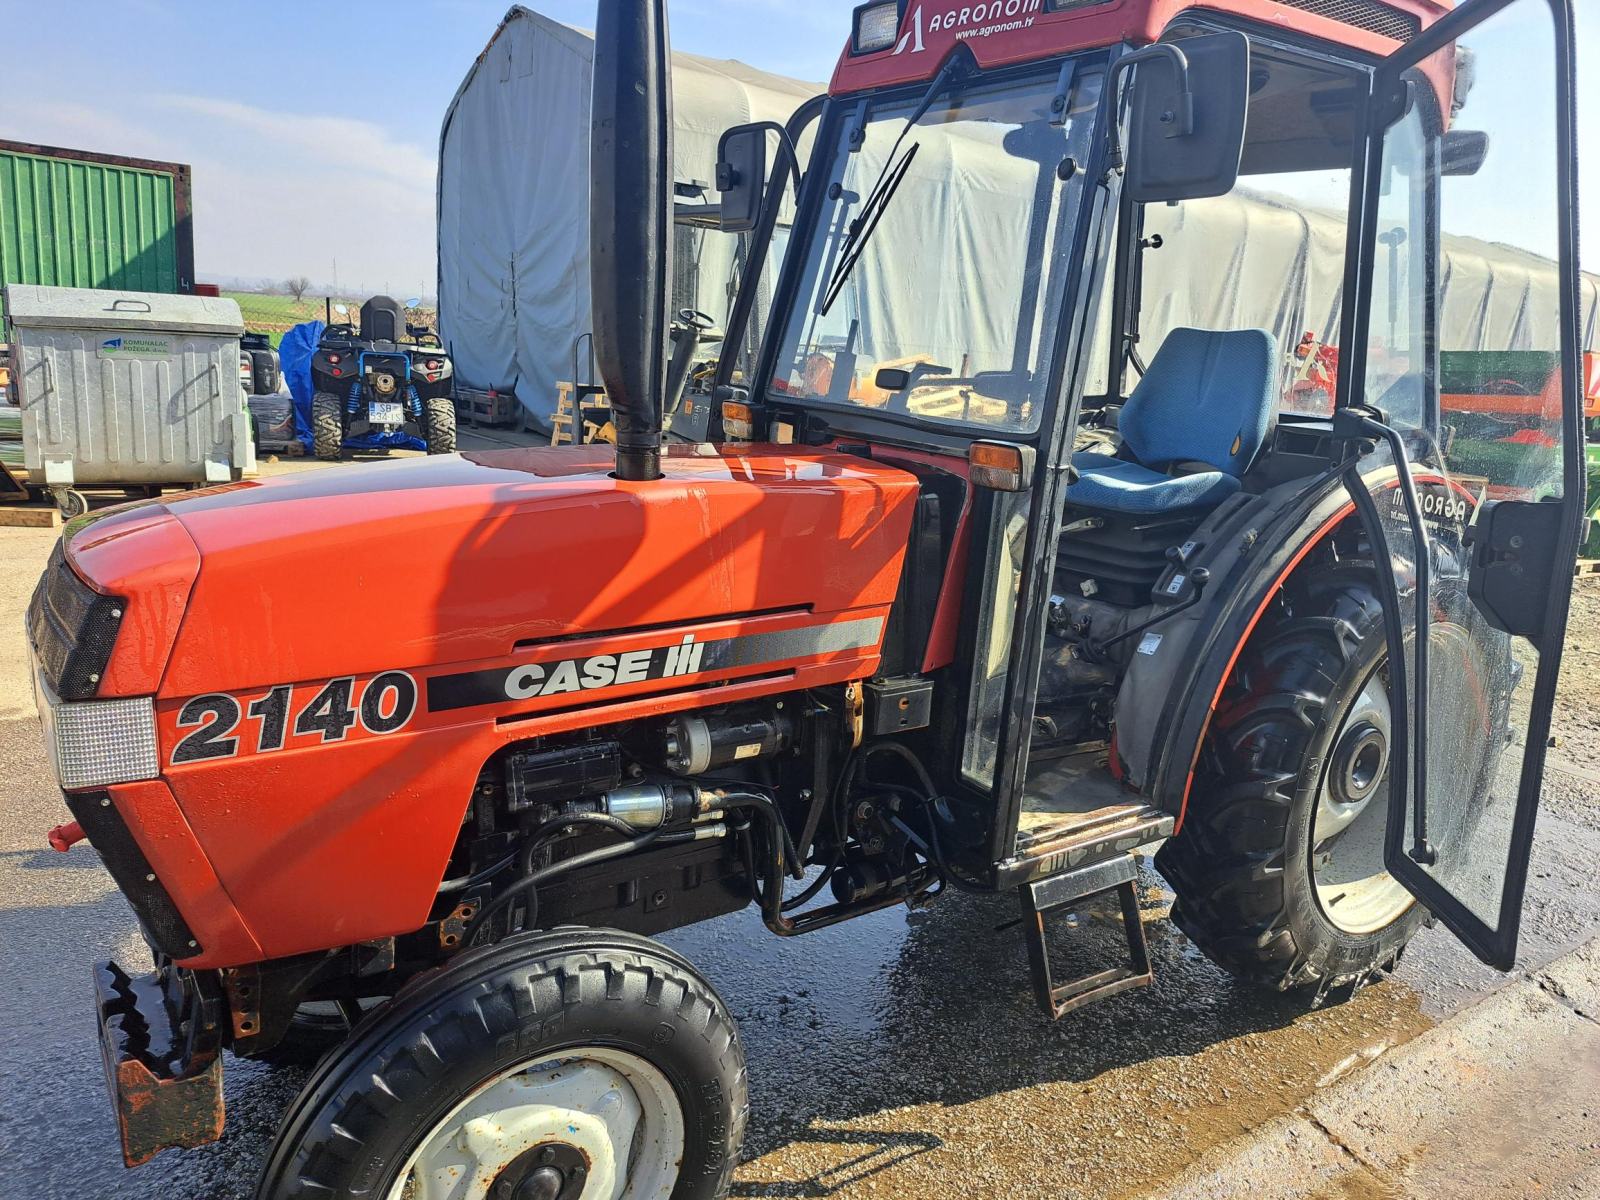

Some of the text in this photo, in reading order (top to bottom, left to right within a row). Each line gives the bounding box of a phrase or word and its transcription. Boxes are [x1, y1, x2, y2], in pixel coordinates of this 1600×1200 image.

[123, 339, 169, 347] KOMUNALAC
[379, 403, 392, 413] SB
[504, 651, 653, 700] CASE
[170, 669, 419, 767] 2140
